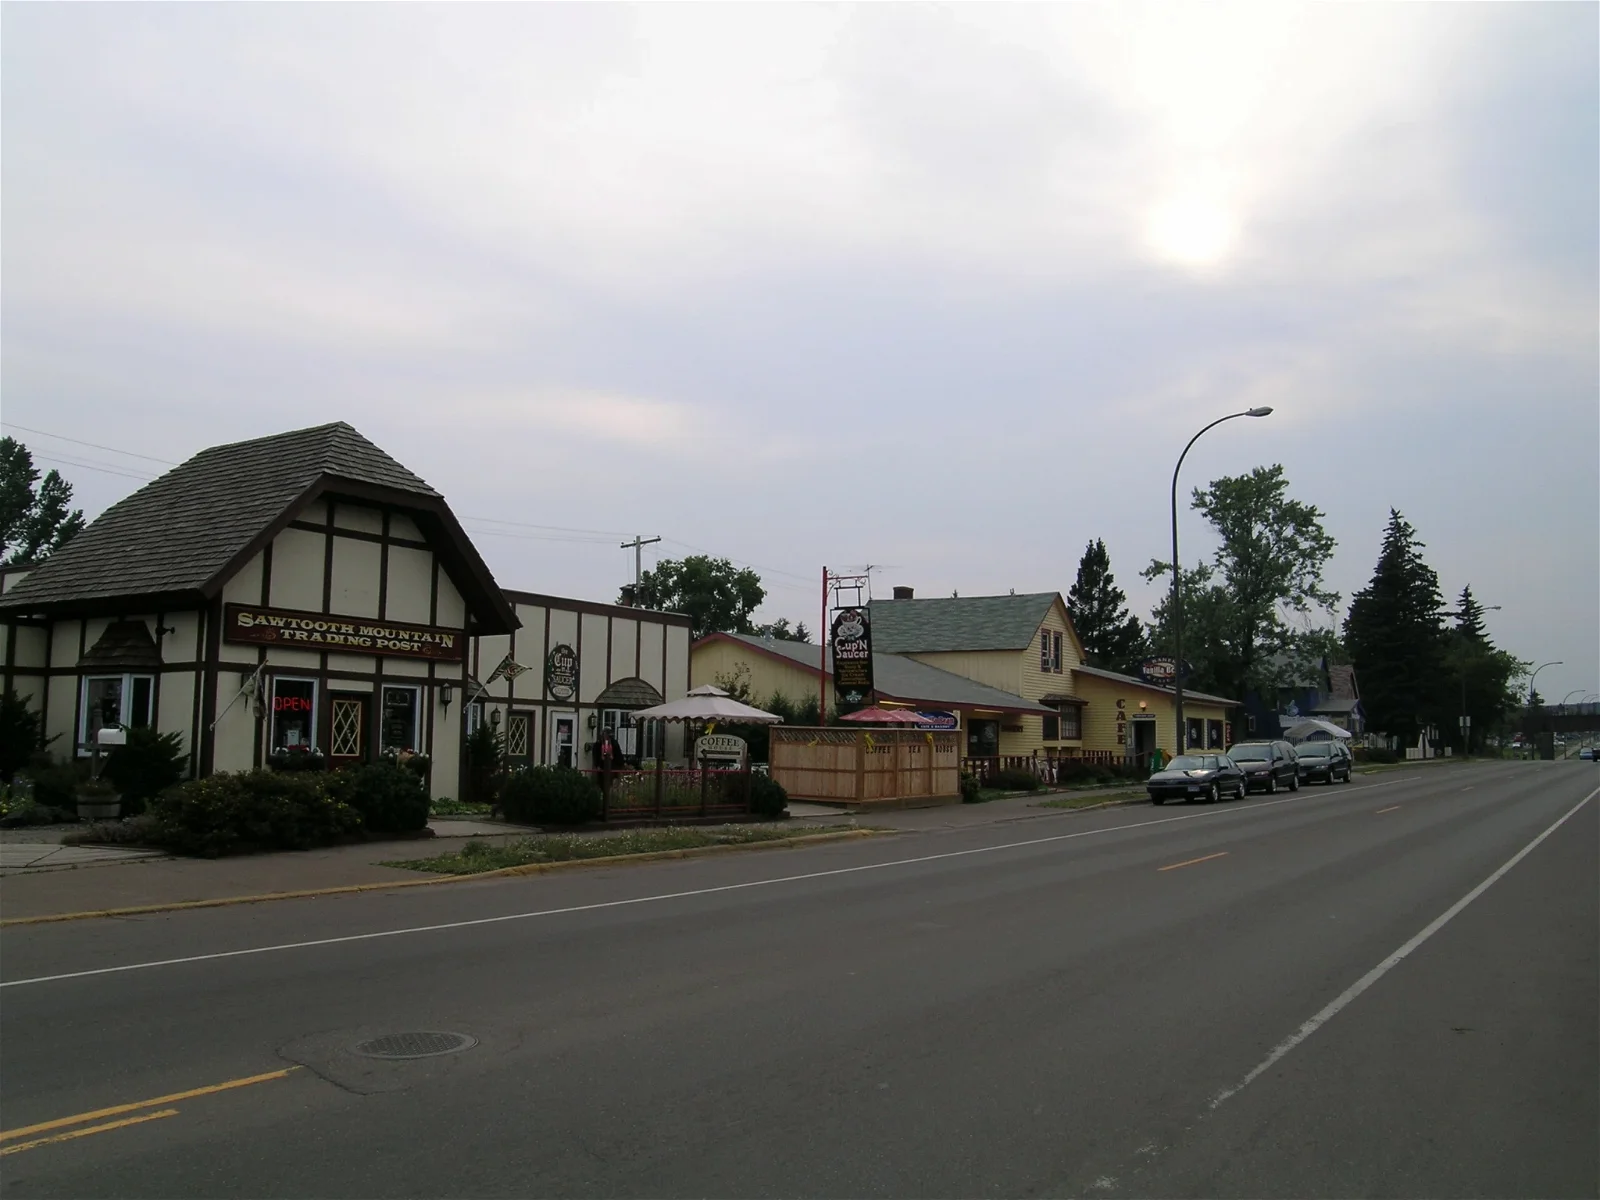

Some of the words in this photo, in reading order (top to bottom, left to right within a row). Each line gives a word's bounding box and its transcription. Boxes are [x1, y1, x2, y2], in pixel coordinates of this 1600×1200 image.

[237, 612, 354, 634] SAWTOOTH
[359, 625, 455, 649] MOUNTAIN
[280, 629, 373, 647] TRADING
[376, 638, 422, 652] POST
[834, 636, 868, 653] Cup'N
[836, 646, 869, 659] Saucer
[554, 652, 573, 671] Cup
[1142, 666, 1165, 674] Vanilla
[273, 696, 311, 712] OPEN
[1116, 699, 1127, 745] CAFE
[700, 737, 740, 748] COFFEE
[908, 745, 921, 753] TEA
[935, 745, 953, 753] HOUSE
